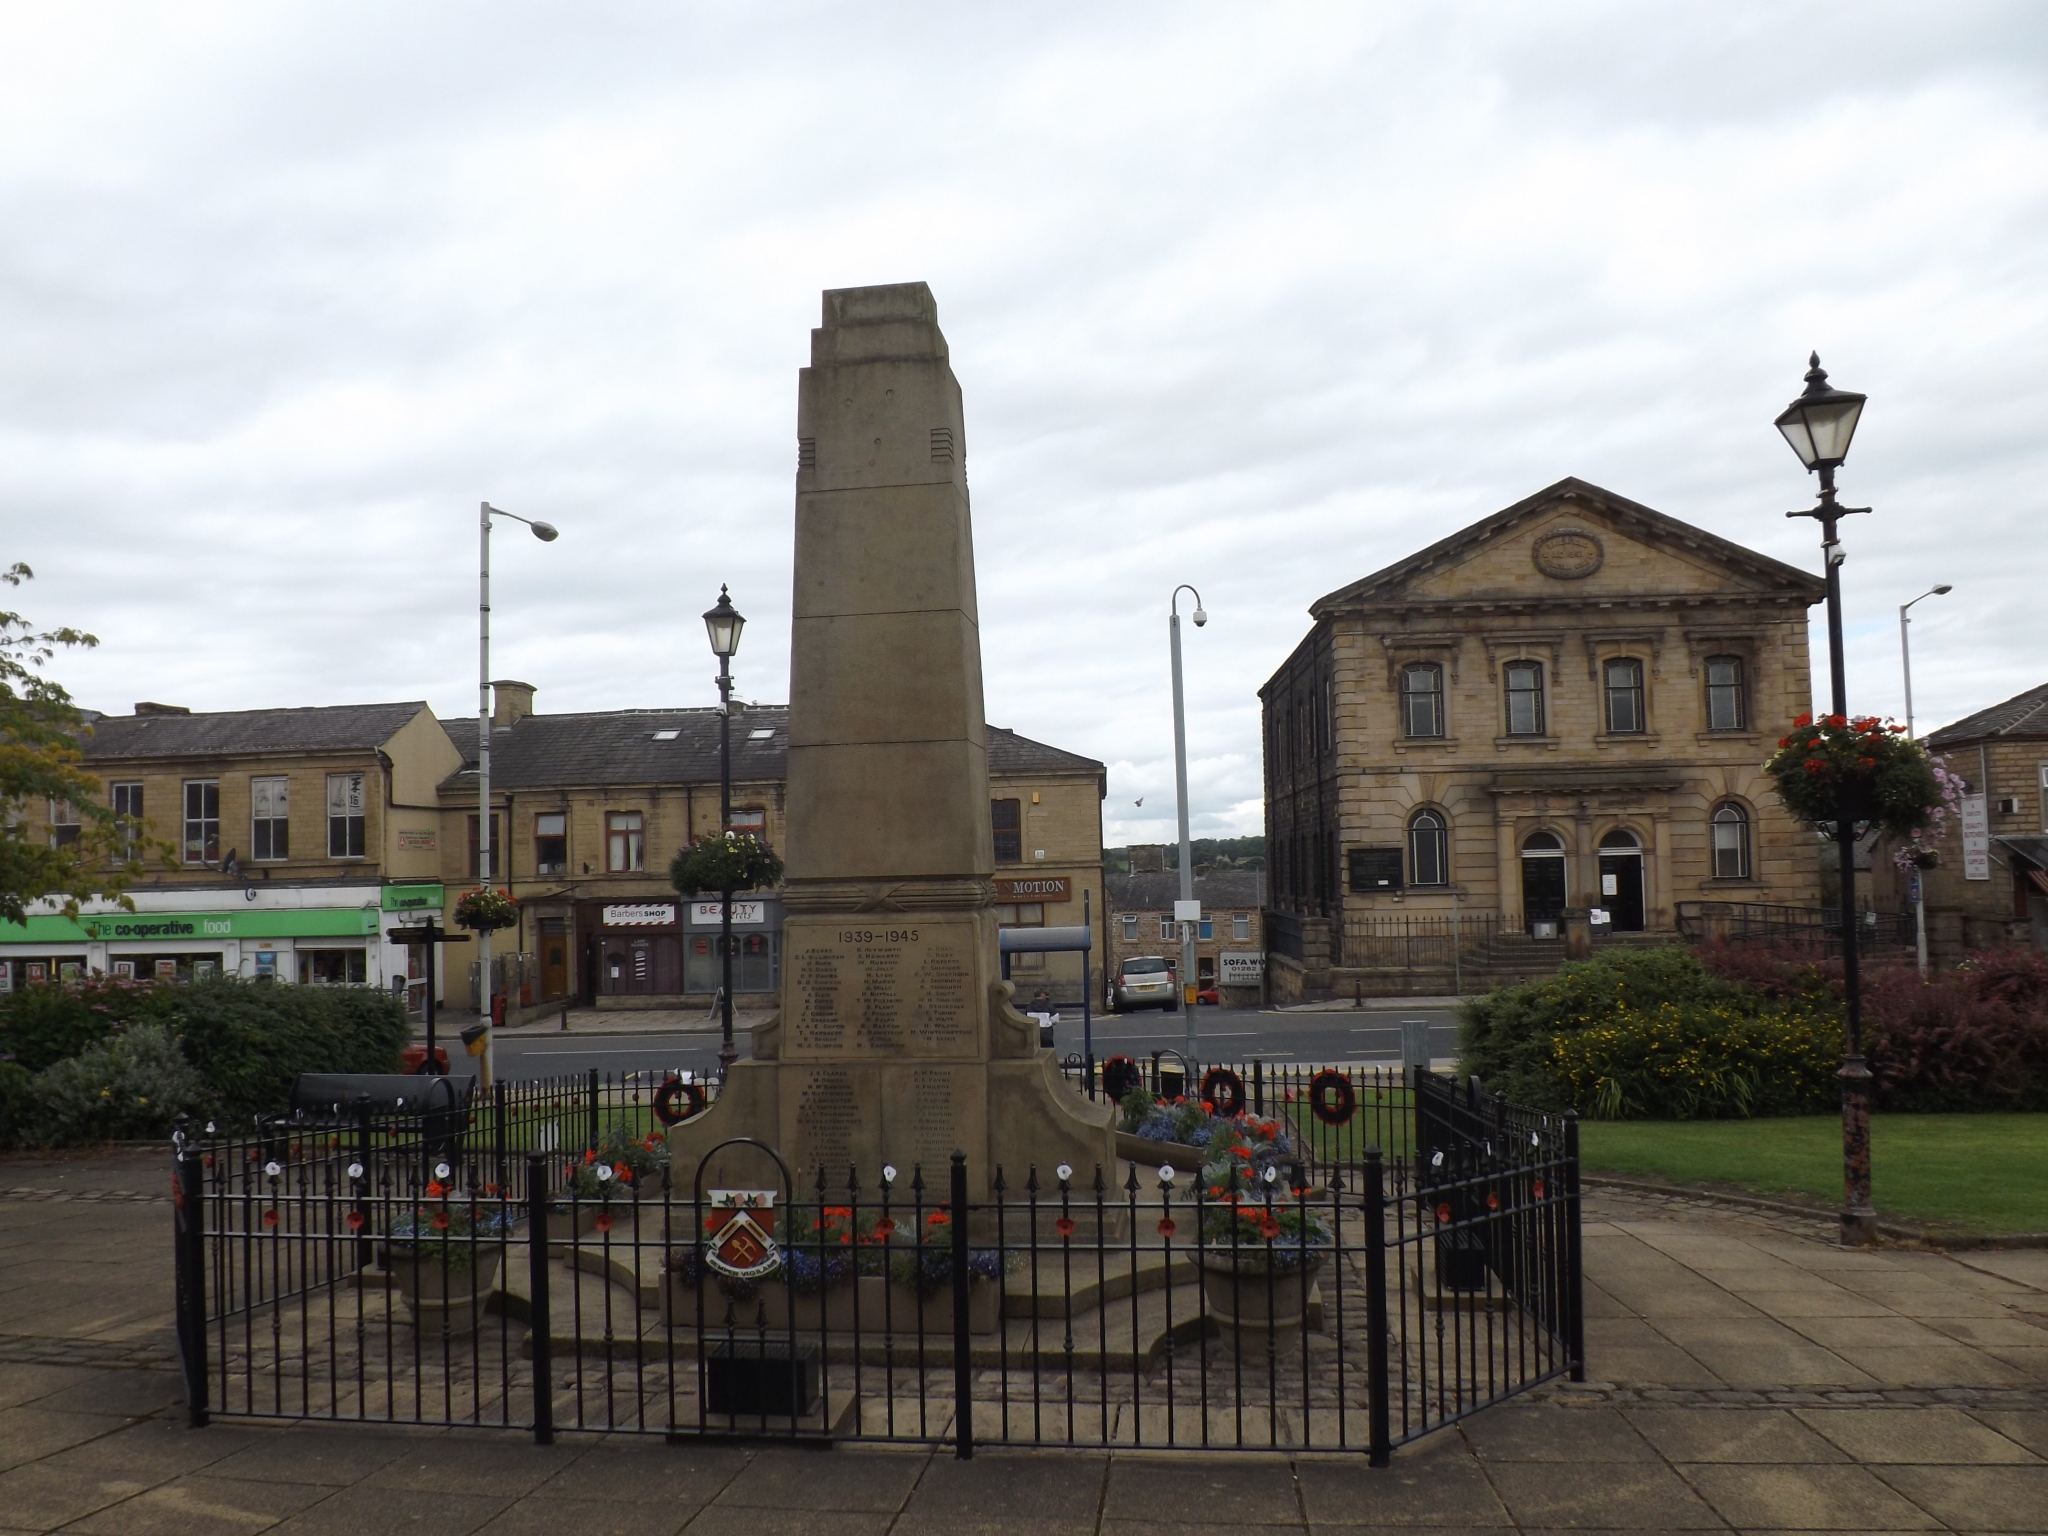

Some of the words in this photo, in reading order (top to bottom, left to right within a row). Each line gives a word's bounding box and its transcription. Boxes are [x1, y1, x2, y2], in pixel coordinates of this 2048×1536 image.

[1013, 880, 1065, 893] MOTION
[610, 909, 643, 918] Barbers
[700, 904, 757, 915] BEUTY
[114, 920, 194, 938] co-operative
[204, 919, 231, 934] food
[838, 930, 919, 943] 1939-1945
[709, 1259, 739, 1277] SEMPER
